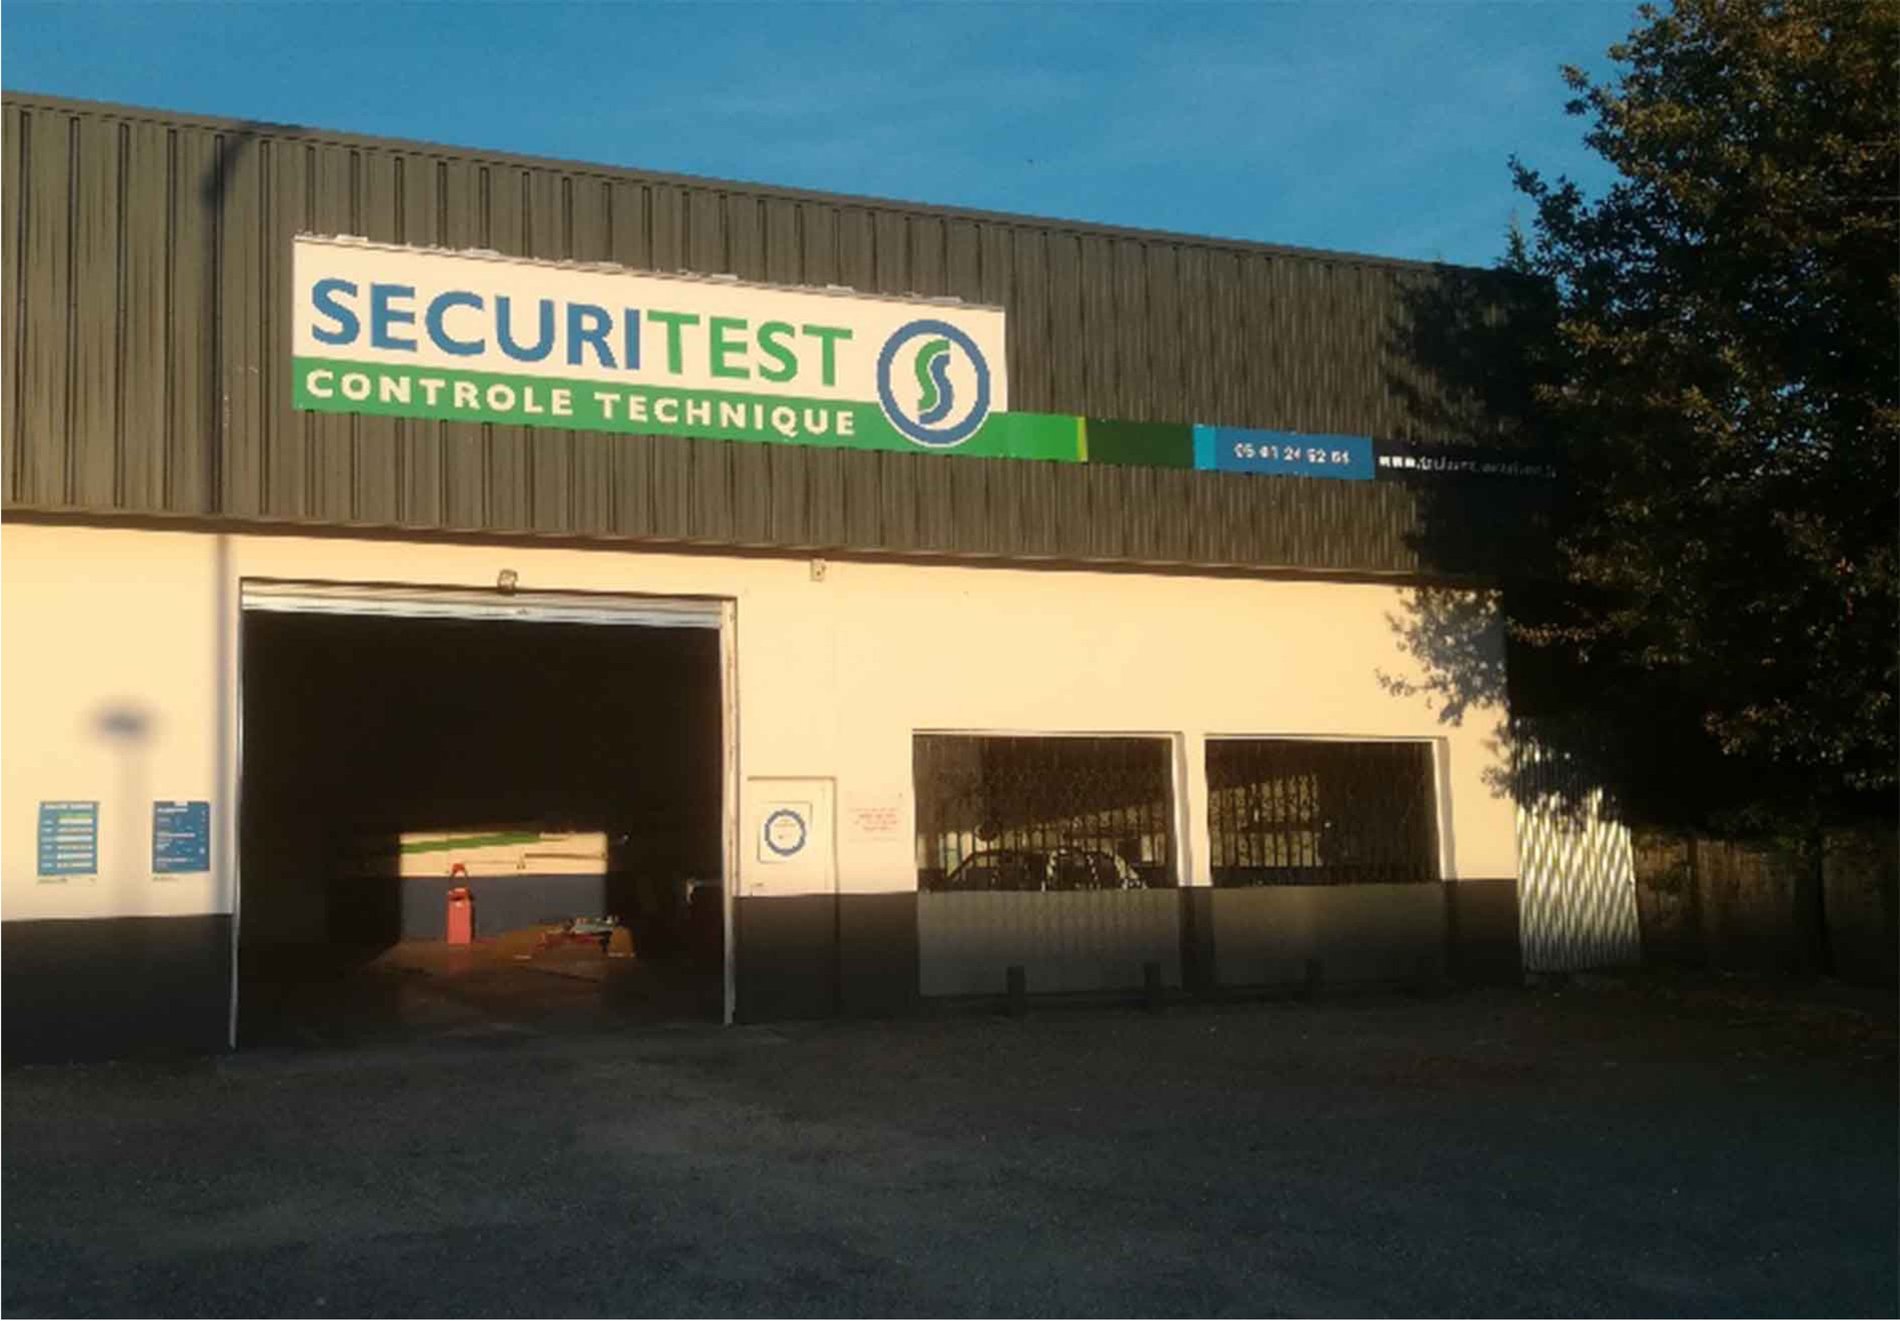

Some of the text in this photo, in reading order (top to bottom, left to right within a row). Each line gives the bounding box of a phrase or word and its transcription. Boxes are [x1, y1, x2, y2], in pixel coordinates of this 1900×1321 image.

[312, 278, 853, 387] SECURITEST
[306, 369, 856, 438] CONTROLE TECHNIQUE
